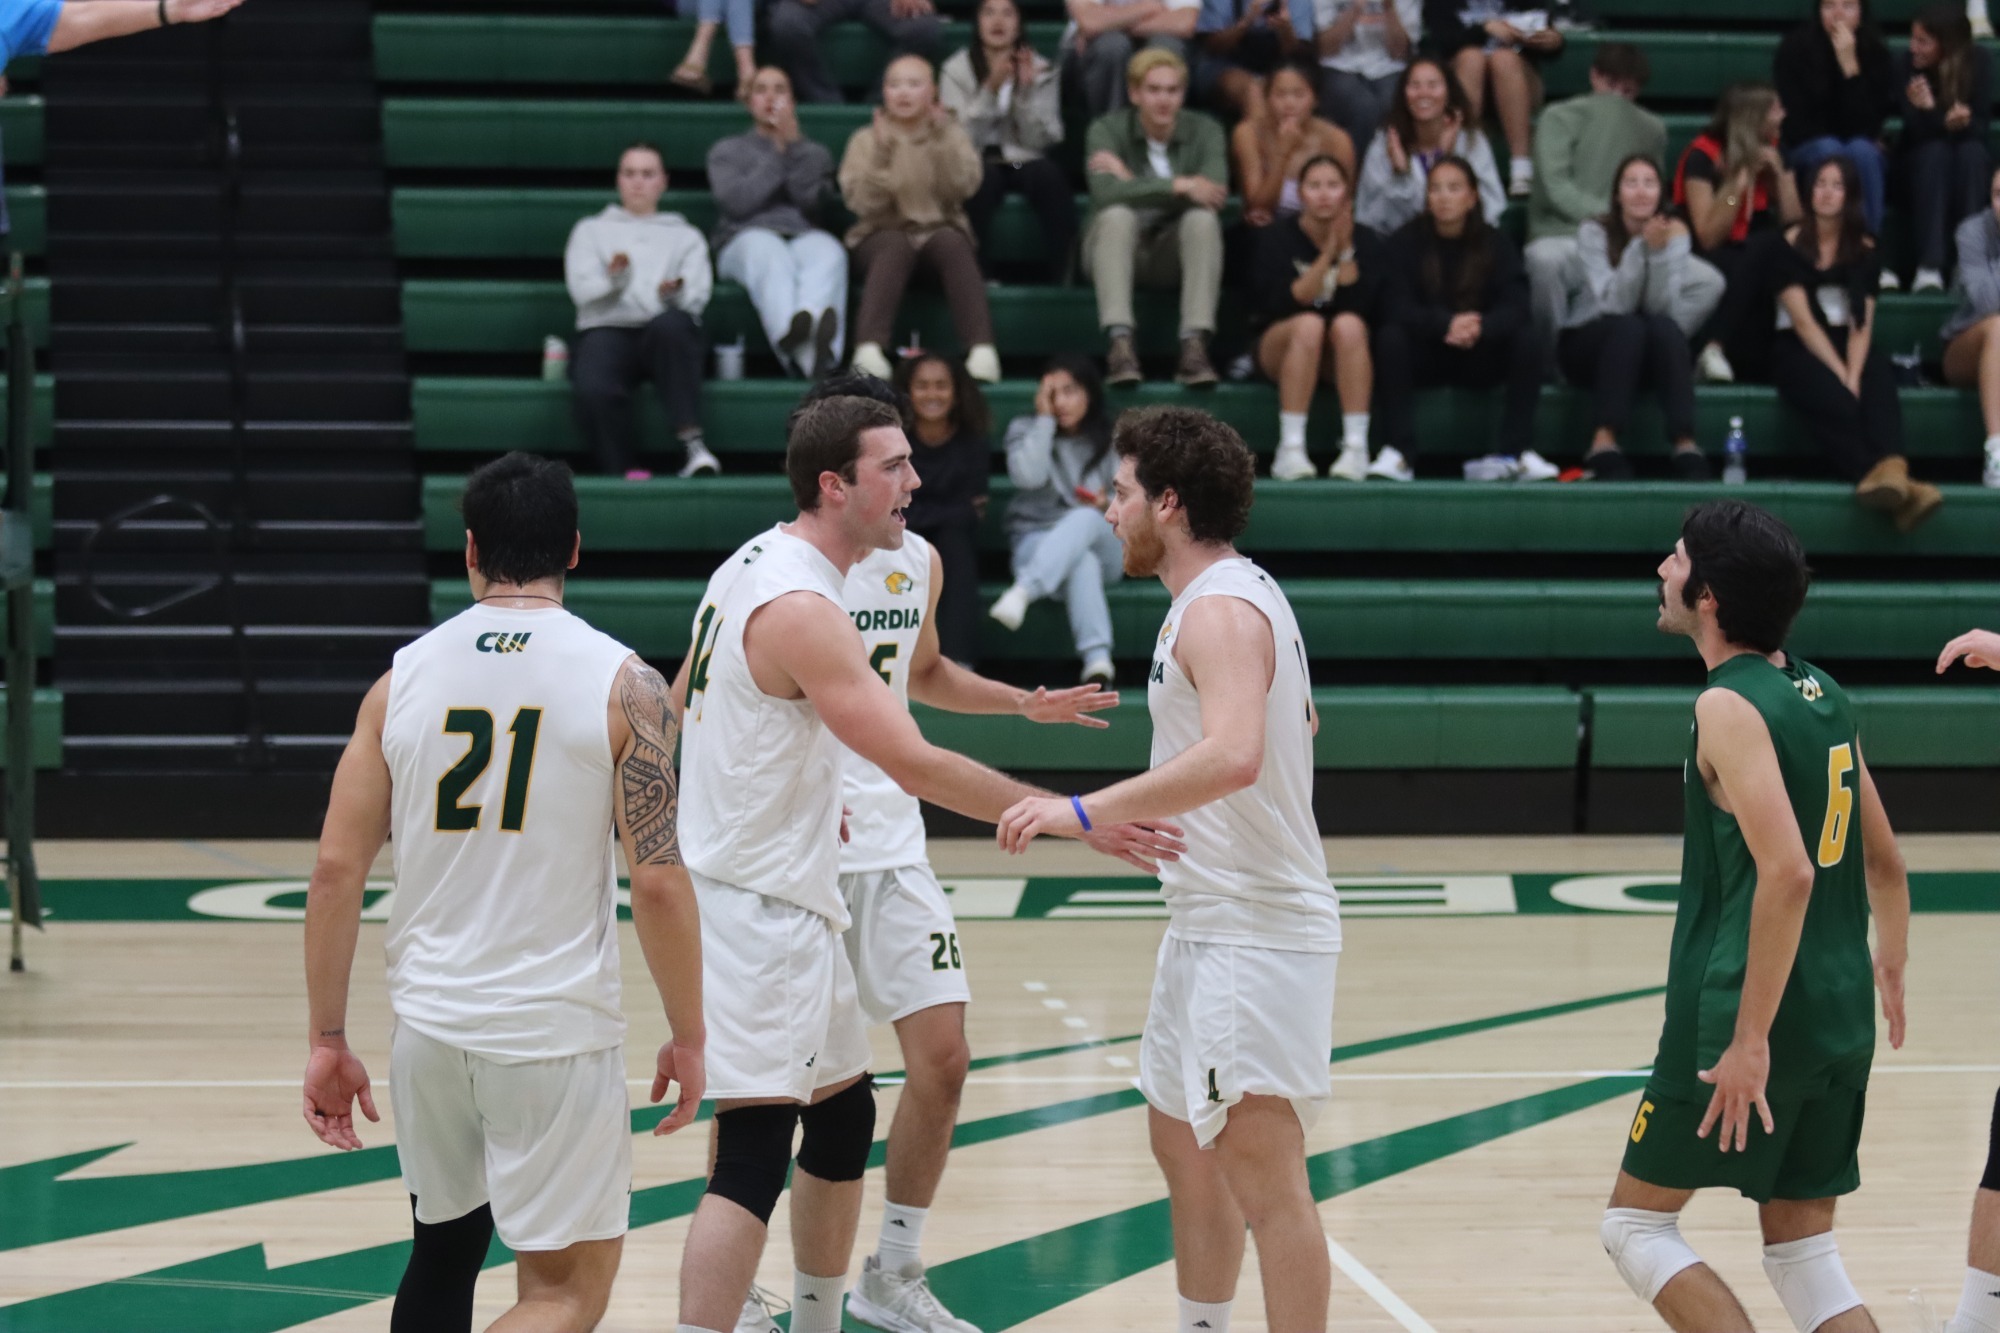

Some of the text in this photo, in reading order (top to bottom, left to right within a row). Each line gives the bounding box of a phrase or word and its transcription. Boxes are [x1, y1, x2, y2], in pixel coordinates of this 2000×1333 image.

[849, 608, 920, 632] ORDIA
[476, 631, 532, 653] CUI
[434, 705, 544, 834] 21
[1817, 742, 1854, 867] 6
[930, 932, 961, 971] 26
[1631, 1100, 1655, 1143] 6
